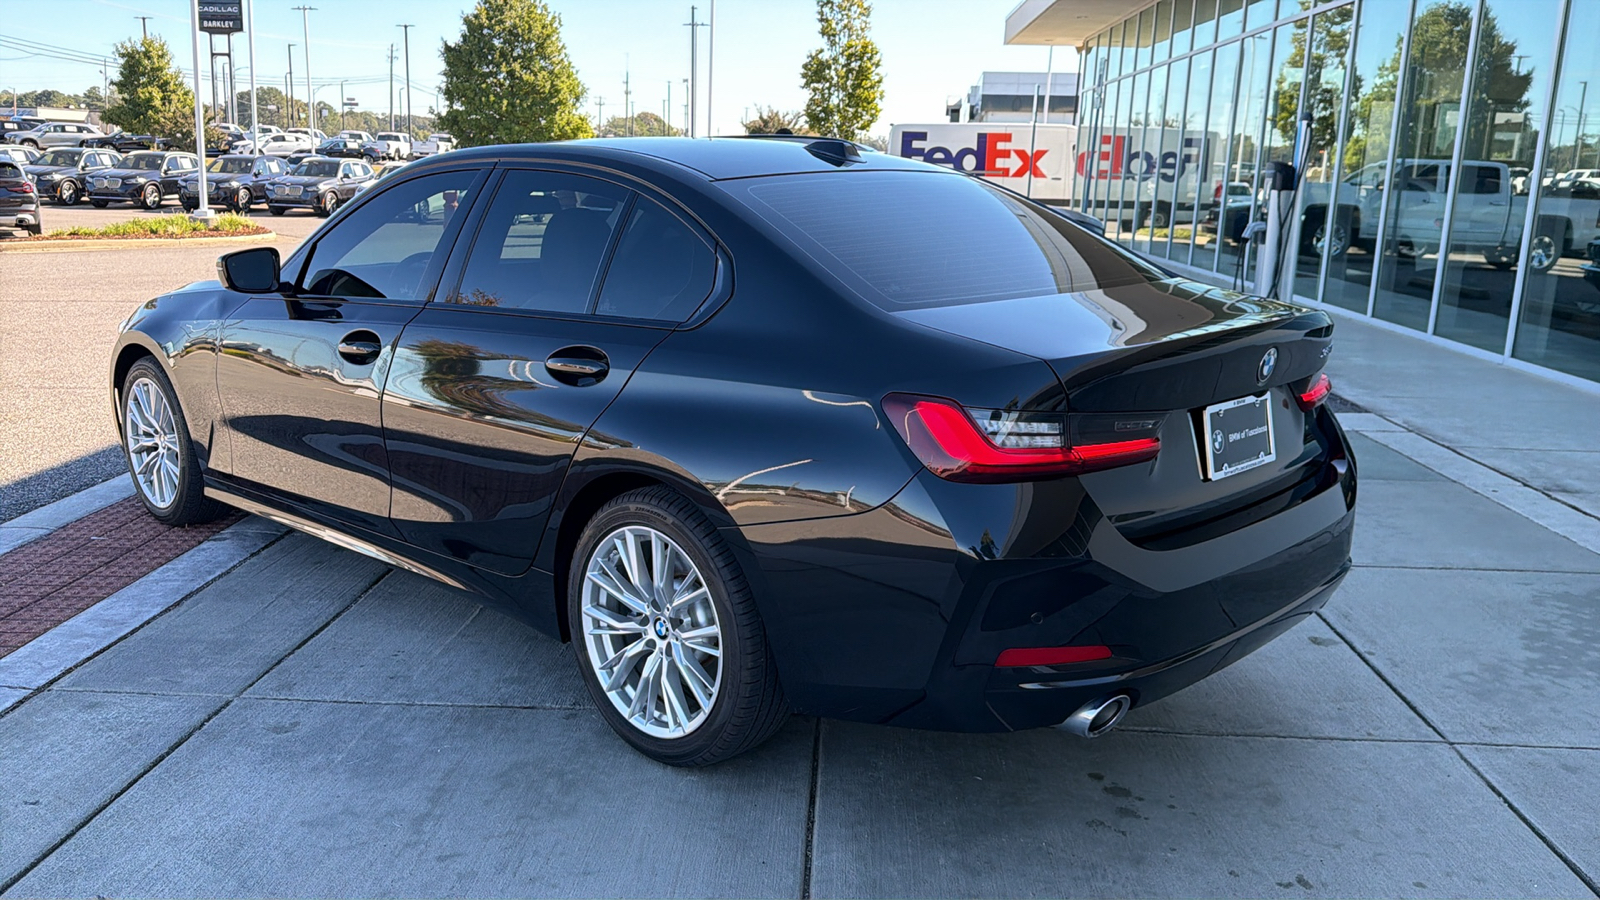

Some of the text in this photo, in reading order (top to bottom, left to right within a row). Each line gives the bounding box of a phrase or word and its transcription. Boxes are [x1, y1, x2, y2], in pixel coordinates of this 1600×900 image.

[203, 20, 234, 28] BARKLEY
[901, 131, 1049, 178] FedEx
[1228, 431, 1241, 443] BMW
